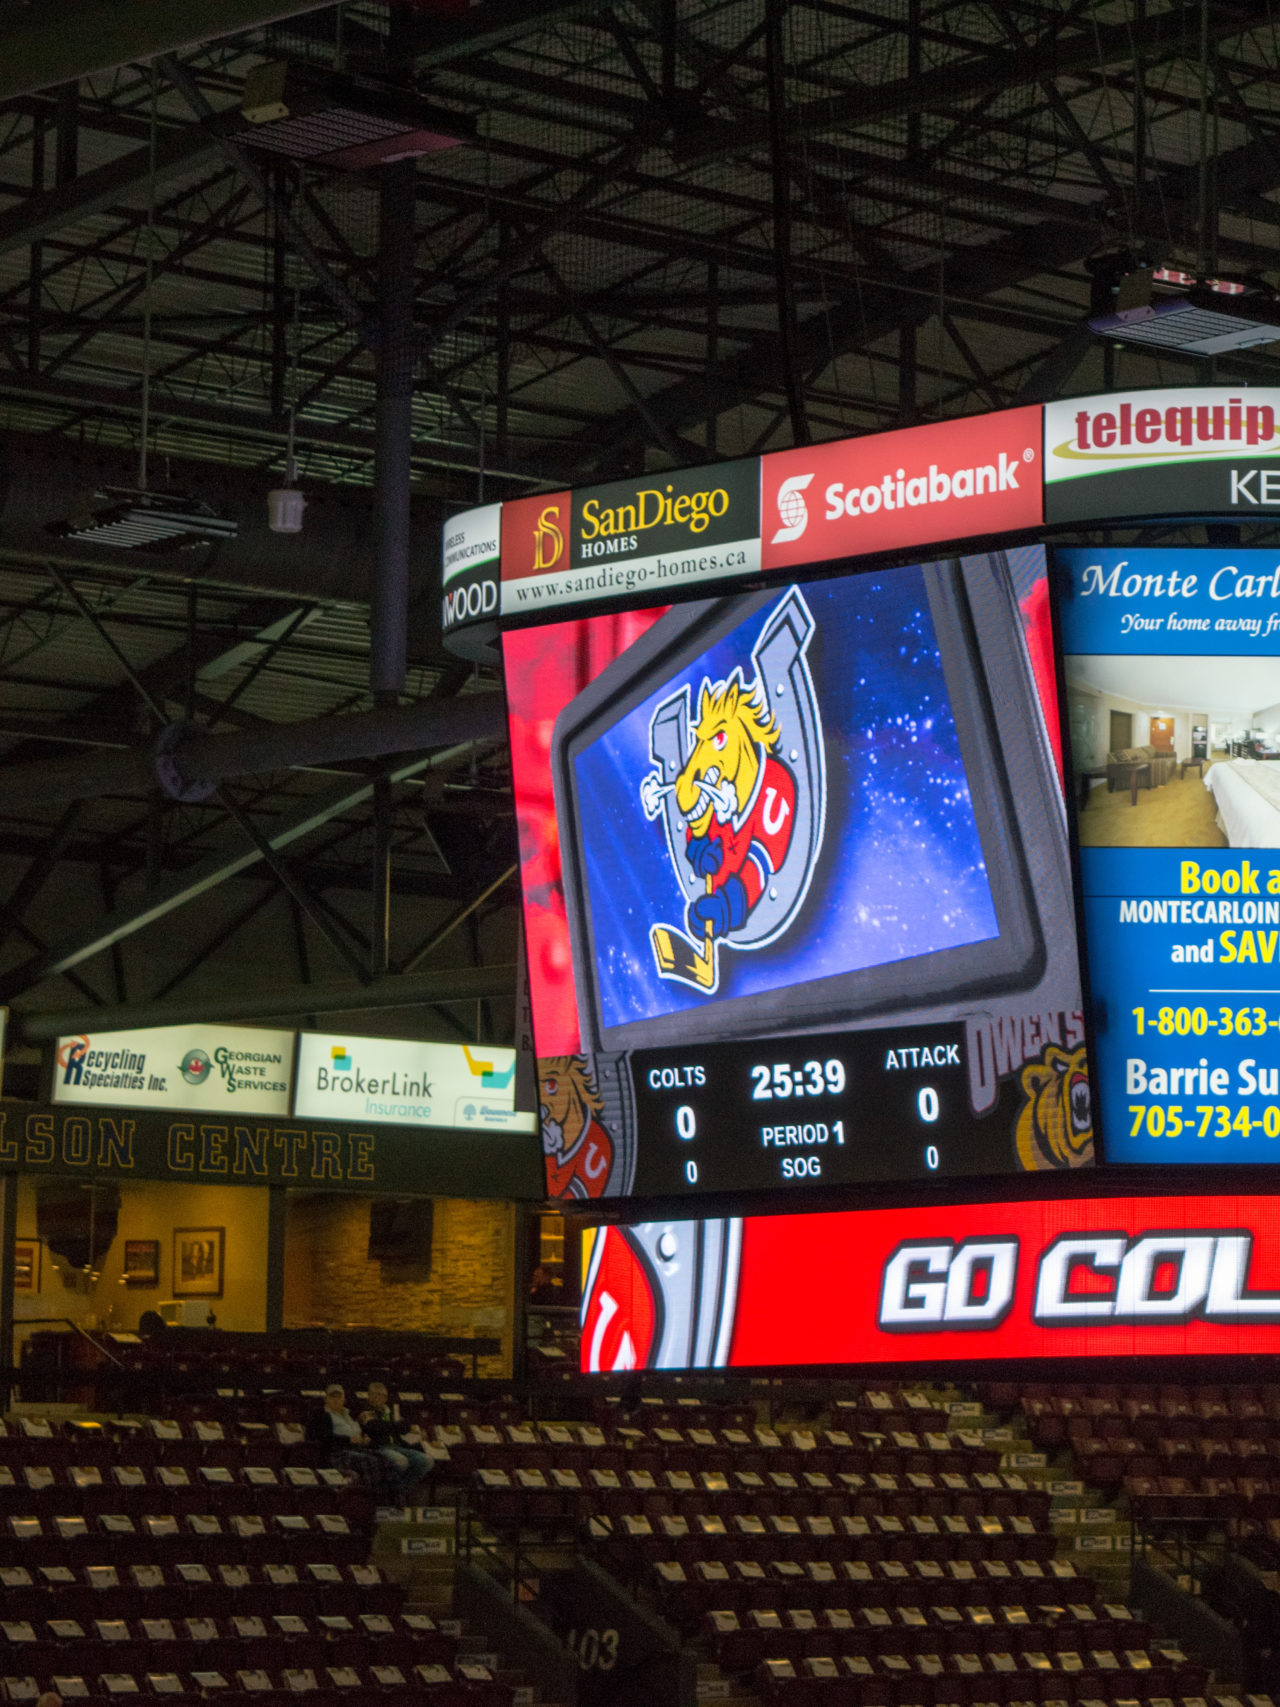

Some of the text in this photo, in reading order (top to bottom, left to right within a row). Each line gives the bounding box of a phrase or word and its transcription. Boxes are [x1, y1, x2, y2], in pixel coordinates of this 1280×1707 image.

[1075, 398, 1276, 450] telequip
[825, 452, 1020, 521] Scotiabank
[581, 484, 730, 540] SanDiego
[581, 535, 638, 559] HOMES
[517, 550, 747, 602] www.sandiego-homes.ca
[1080, 561, 1199, 598] Monte
[1120, 612, 1164, 634] Your
[1166, 612, 1211, 632] home
[1214, 617, 1261, 637] away
[1181, 860, 1261, 895] Book
[1171, 938, 1214, 964] and
[63, 1042, 147, 1086] Recycling
[213, 1047, 283, 1065] GEORGIAN
[219, 1063, 267, 1079] WASTE
[885, 1043, 960, 1071] ATTACK
[82, 1069, 168, 1092] Specialties Inc.
[226, 1077, 288, 1094] SERVICES
[316, 1066, 434, 1098] BrokerLink
[648, 1065, 707, 1090] COLTS
[752, 1059, 846, 1100] 25:39
[1126, 1058, 1230, 1096] Barrie
[365, 1097, 432, 1118] Insurance
[917, 1086, 940, 1123] 0
[675, 1104, 697, 1141] 0
[762, 1121, 845, 1147] PERIOD 1
[167, 1122, 377, 1182] CENTRE
[782, 1156, 822, 1178] SOG
[926, 1145, 939, 1170] 0
[686, 1159, 698, 1184] 0
[877, 1238, 1018, 1325] GO
